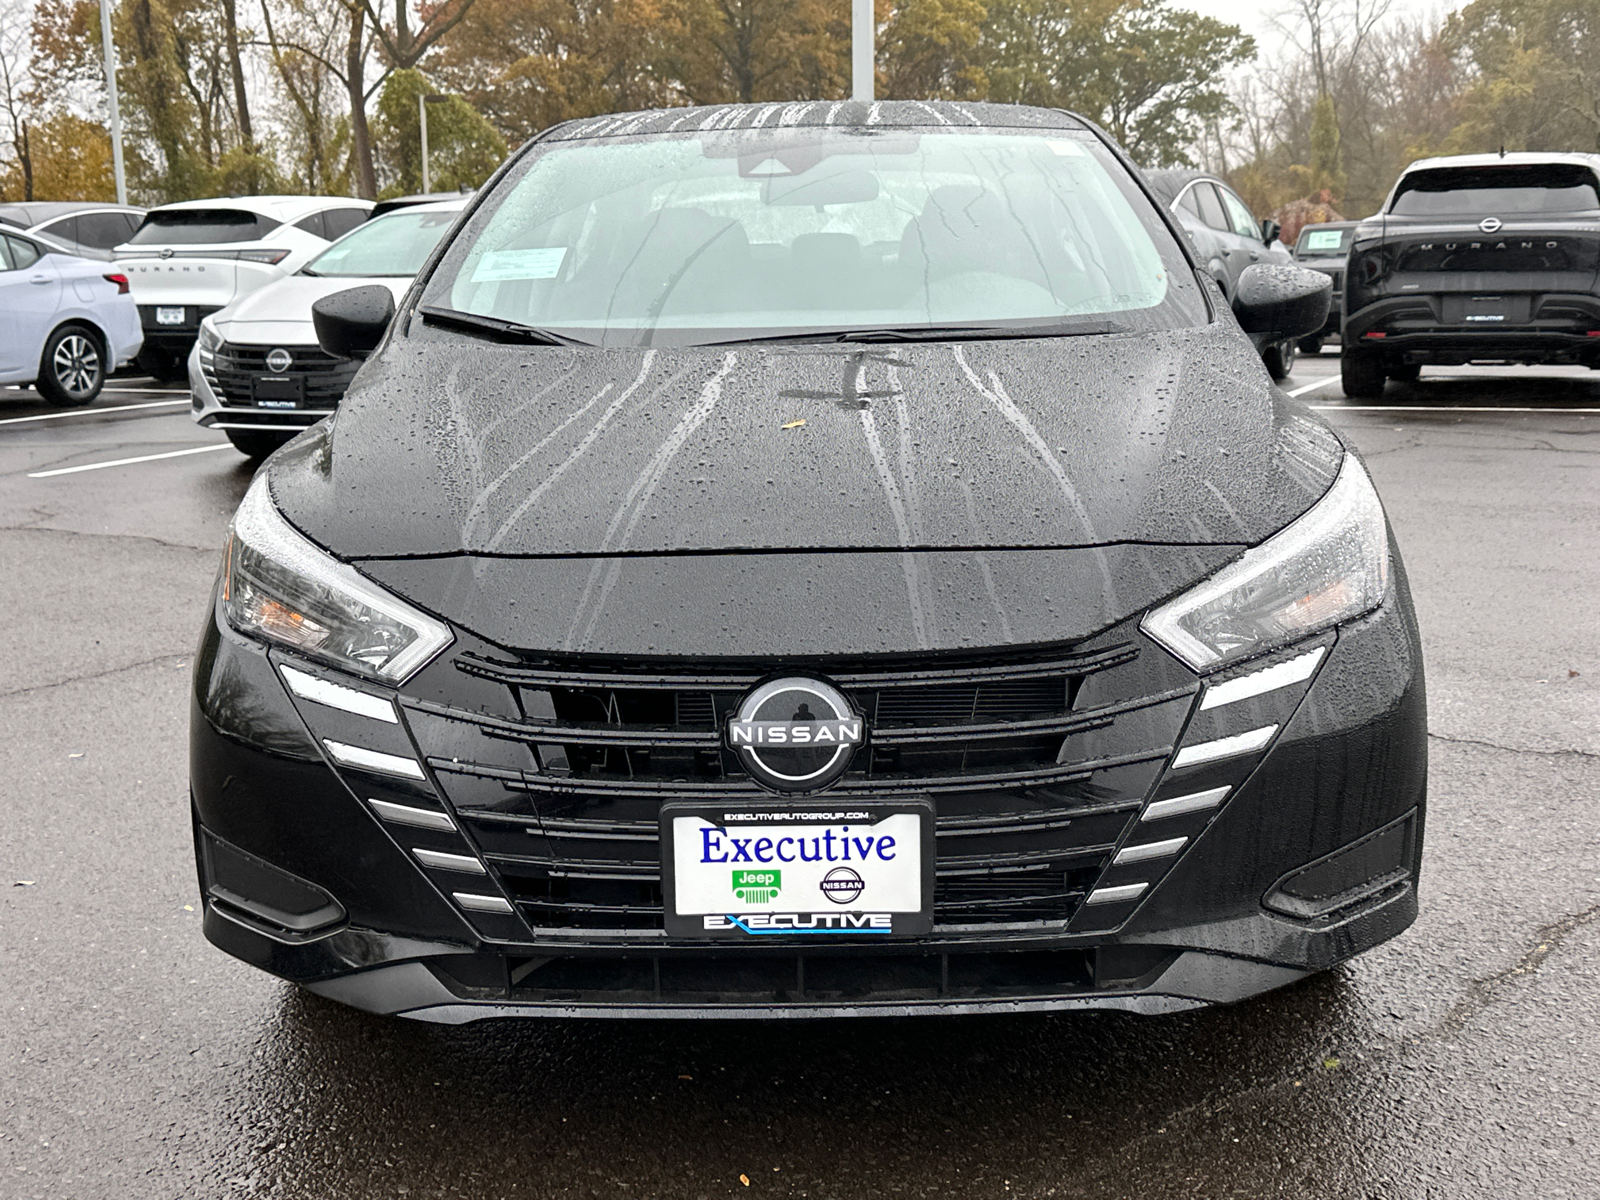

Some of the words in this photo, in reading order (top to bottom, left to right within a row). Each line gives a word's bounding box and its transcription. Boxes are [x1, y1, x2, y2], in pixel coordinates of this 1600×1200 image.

[1421, 240, 1558, 251] MURANO
[732, 723, 860, 743] NISSAN
[723, 811, 870, 821] EXECUTIVEAUTOGROUP.COM
[698, 825, 897, 864] Executive
[738, 871, 775, 886] Jeep
[822, 880, 863, 890] NISSAN
[703, 913, 893, 934] EXECUTIVE
